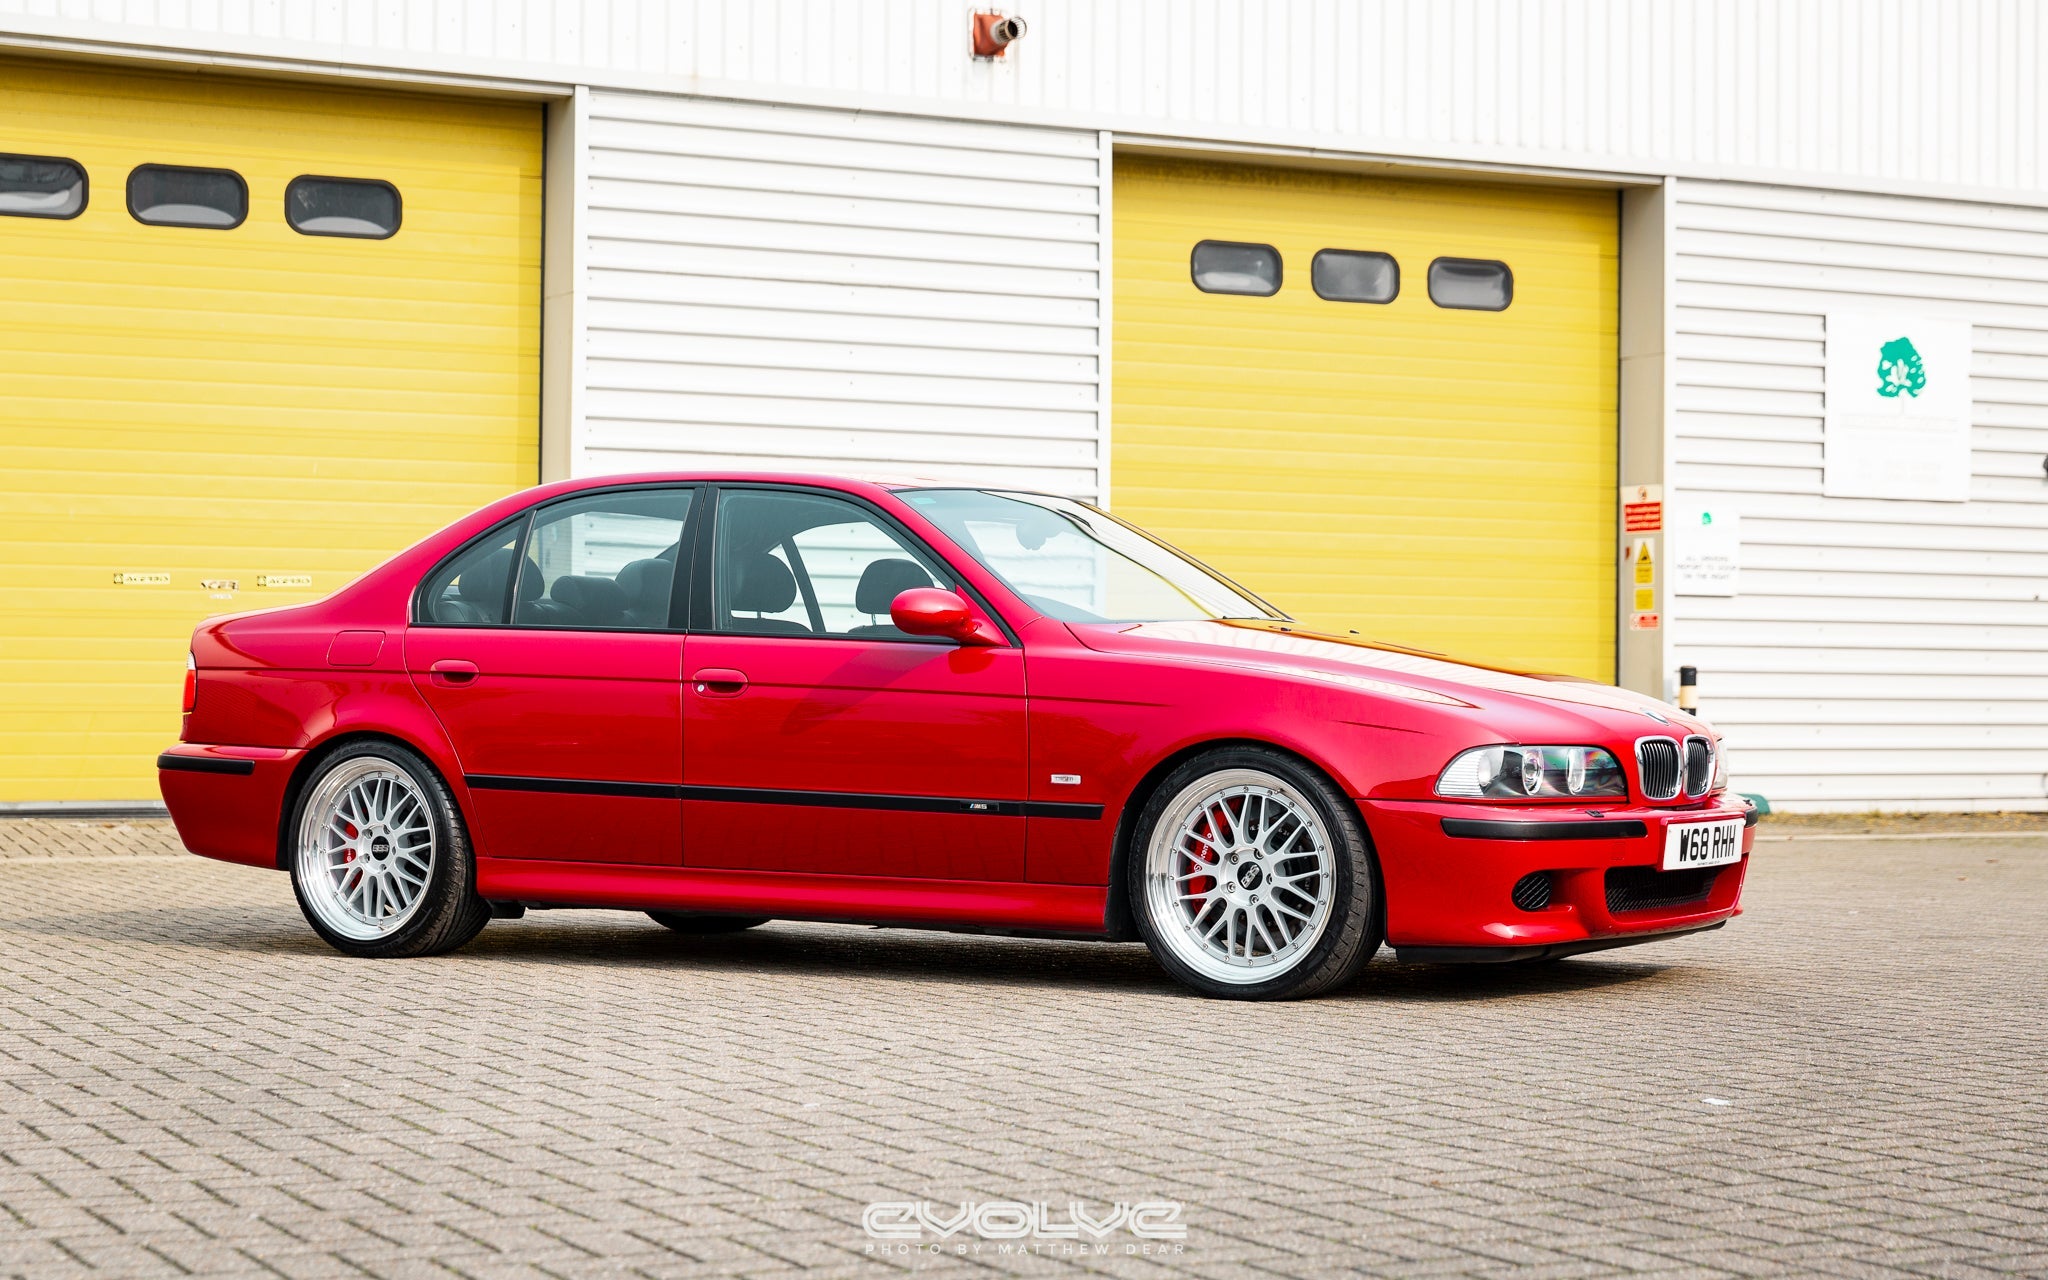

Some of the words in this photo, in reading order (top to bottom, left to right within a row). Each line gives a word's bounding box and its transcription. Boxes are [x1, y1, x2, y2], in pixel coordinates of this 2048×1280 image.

[1680, 828, 1710, 862] W68
[1712, 824, 1737, 859] RHH
[1240, 864, 1260, 888] BBS
